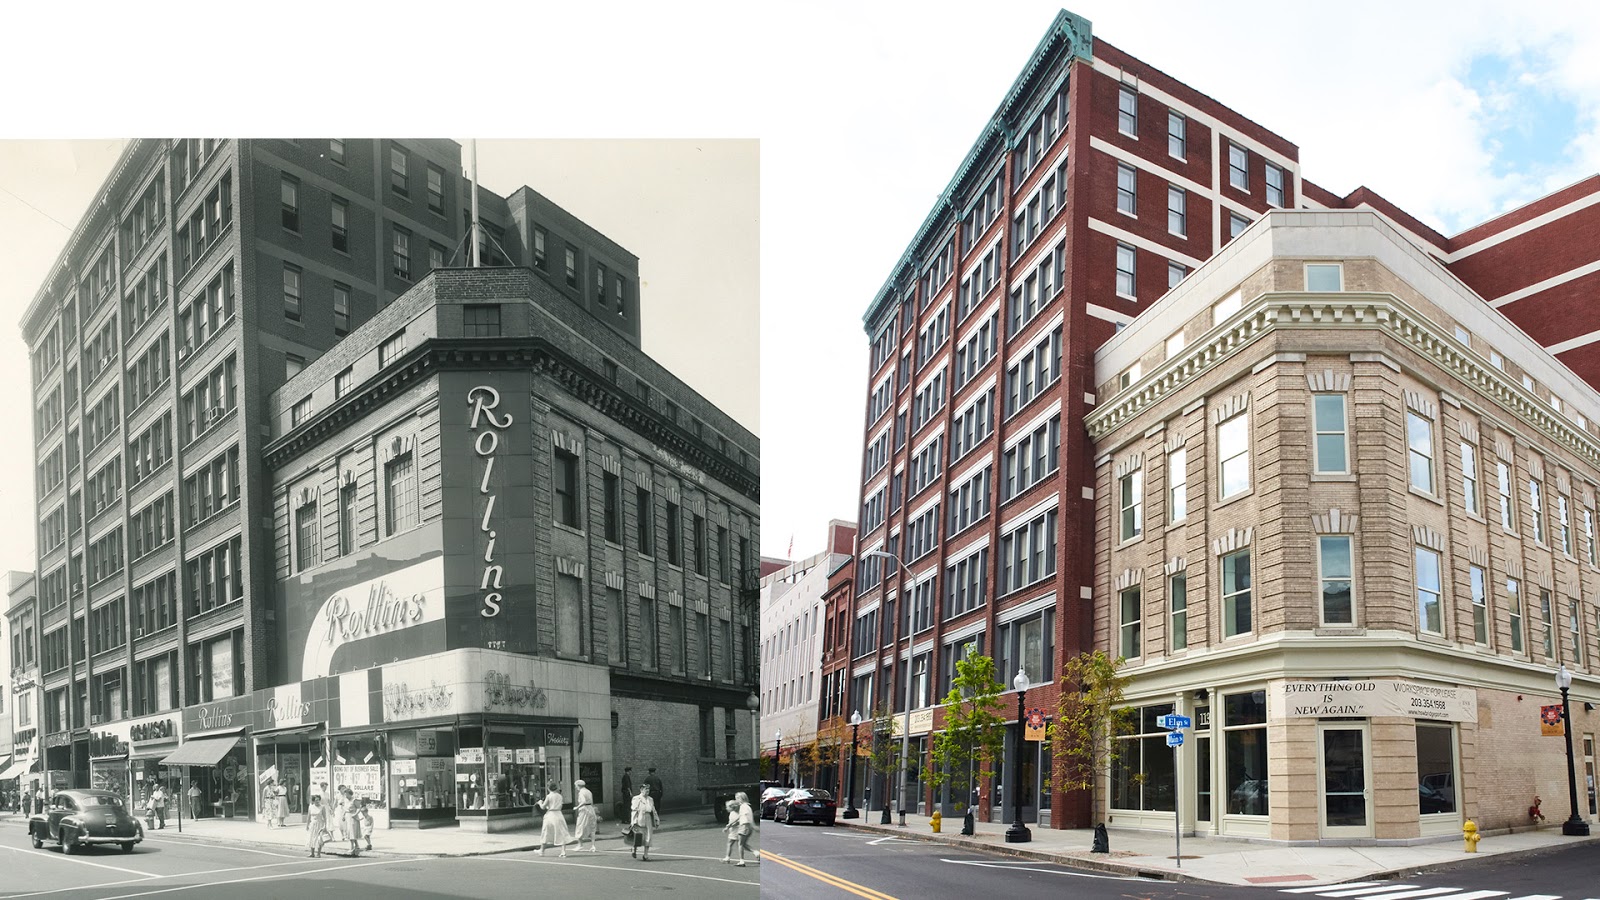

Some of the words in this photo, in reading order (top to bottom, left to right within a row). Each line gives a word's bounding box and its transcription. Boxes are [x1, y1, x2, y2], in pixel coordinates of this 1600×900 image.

[467, 385, 513, 617] Rollins
[326, 580, 426, 642] Rollins
[1355, 682, 1376, 691] OLD
[1323, 694, 1333, 703] IS
[267, 695, 312, 722] Rollins
[1294, 706, 1319, 714] NEW
[199, 707, 233, 729] Rollins
[1168, 717, 1183, 727] Elm
